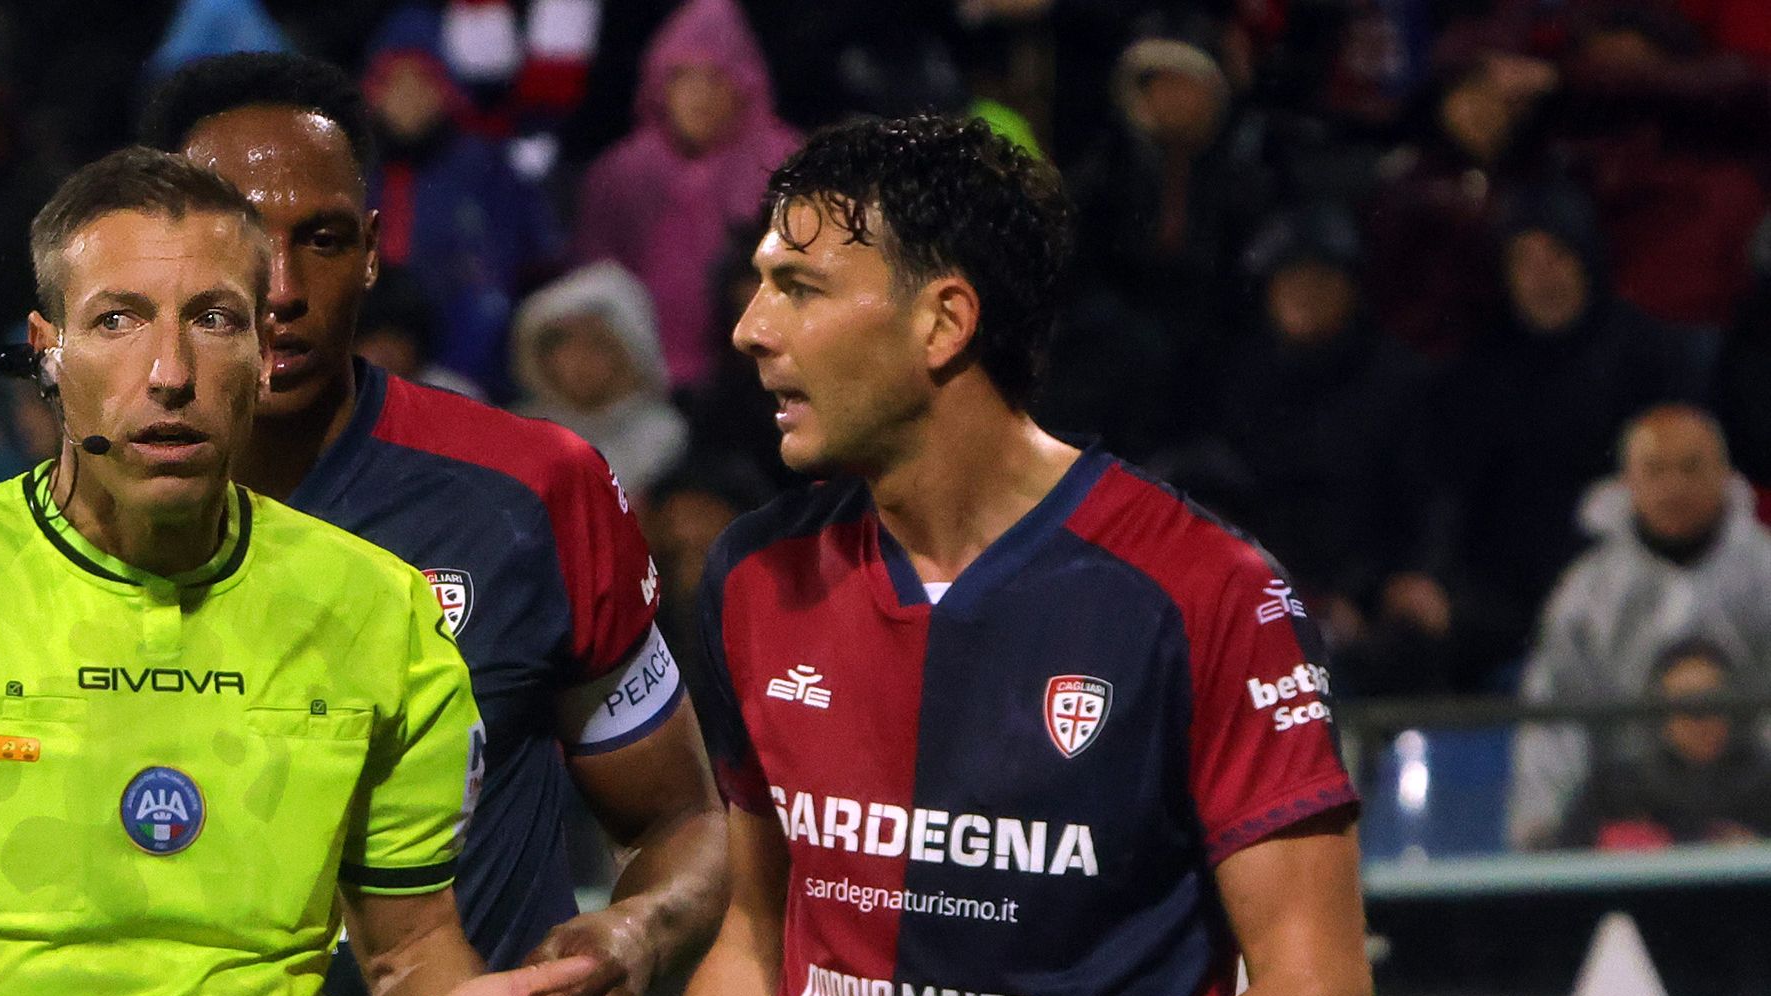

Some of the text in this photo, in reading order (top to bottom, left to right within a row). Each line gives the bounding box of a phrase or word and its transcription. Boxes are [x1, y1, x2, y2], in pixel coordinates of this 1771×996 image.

[427, 574, 465, 583] GLIARI
[78, 667, 244, 695] GIVOVA
[605, 641, 671, 717] PEACE
[1057, 682, 1105, 697] CAGLIARI
[136, 789, 189, 821] AIA
[769, 786, 1100, 877] SARDEGNA
[805, 876, 1020, 924] sardegnaturismo.it
